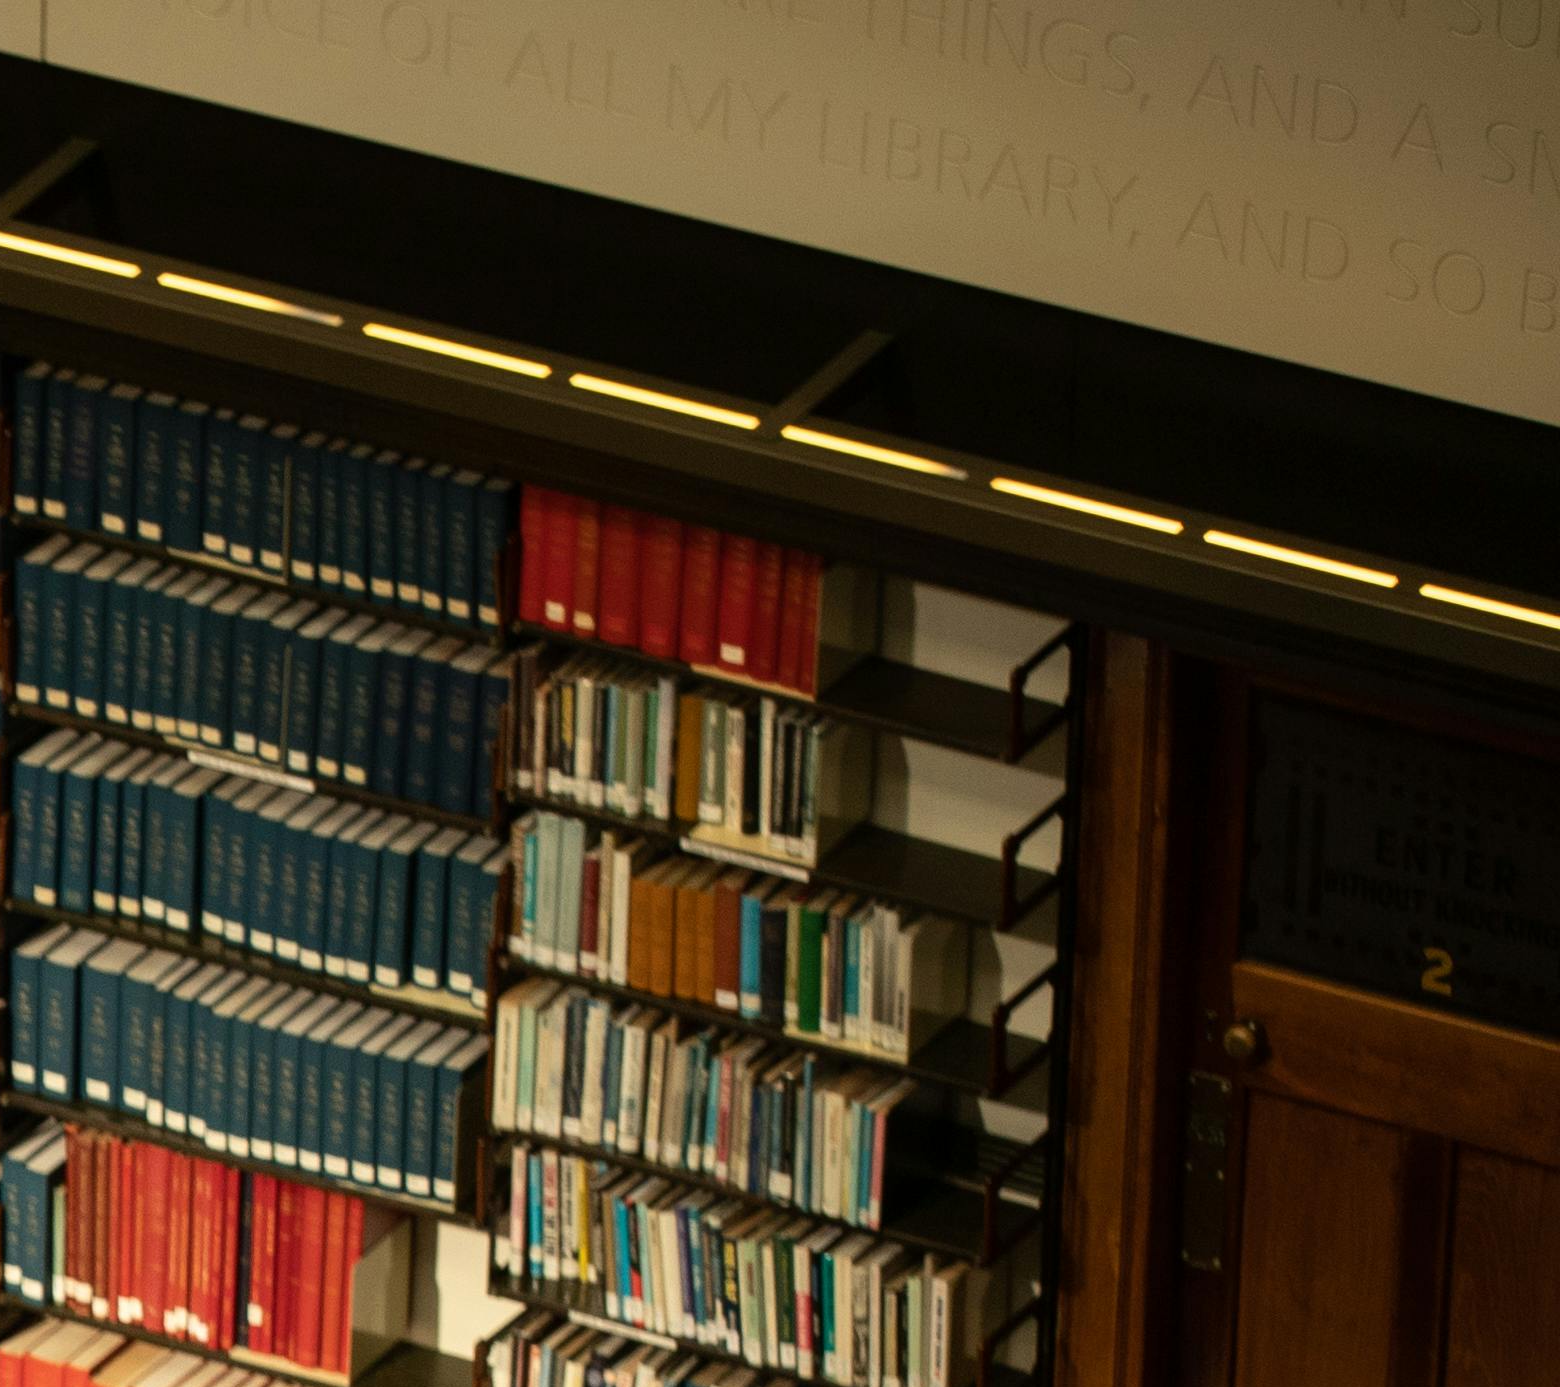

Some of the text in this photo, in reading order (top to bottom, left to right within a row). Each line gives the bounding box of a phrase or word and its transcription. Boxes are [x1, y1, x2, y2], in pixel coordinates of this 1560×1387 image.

[380, 1, 478, 77] OF
[503, 29, 639, 118] ALL
[665, 62, 790, 151] MY
[818, 100, 1140, 248] LIBRARY,
[1176, 190, 1350, 283] AND
[1385, 236, 1487, 317] SO
[1185, 53, 1359, 144] AND
[1390, 101, 1444, 173] A
[1374, 825, 1520, 898] ENTER
[1420, 946, 1456, 997] 2
